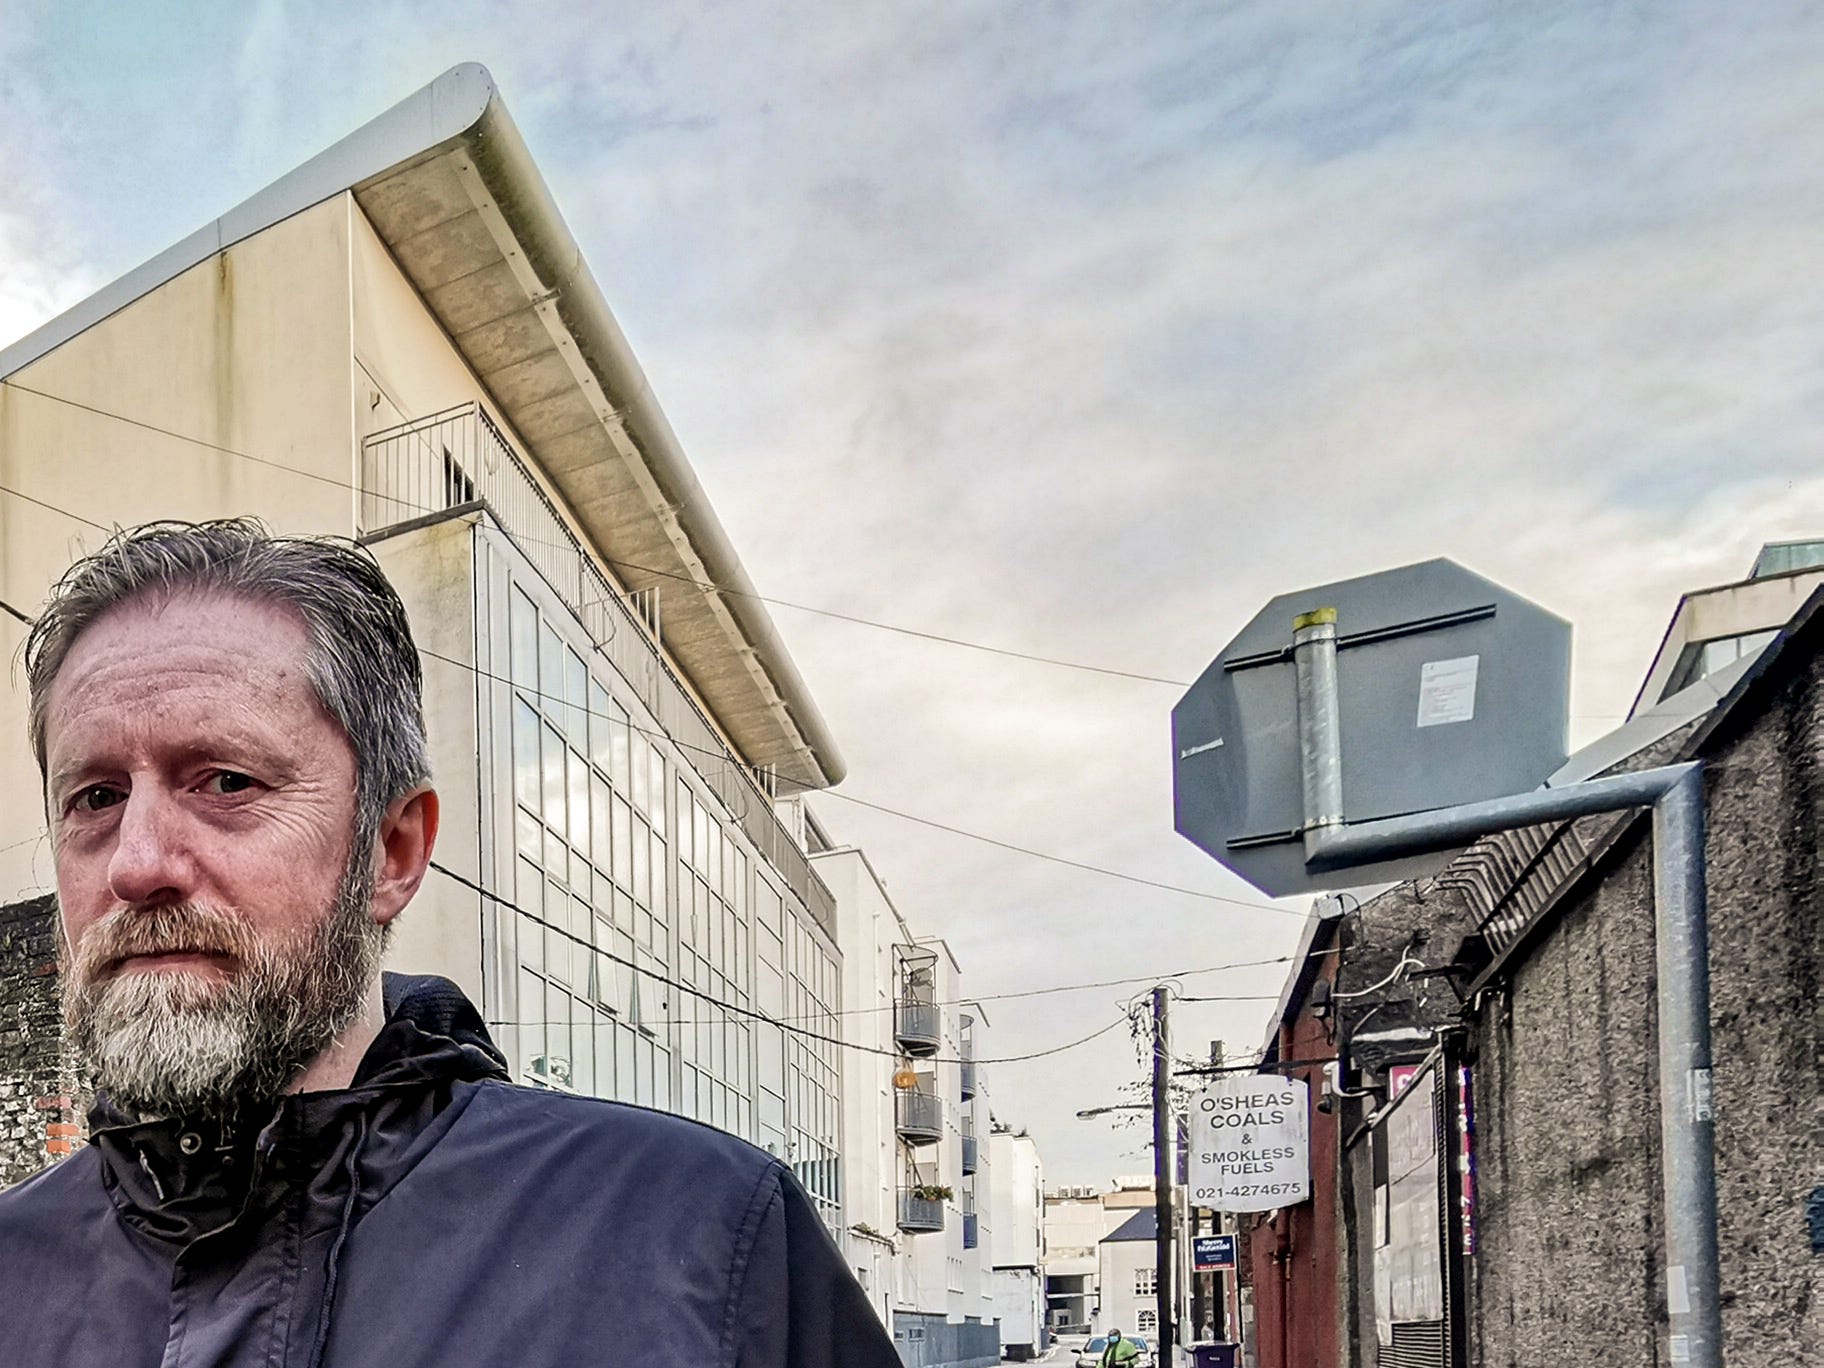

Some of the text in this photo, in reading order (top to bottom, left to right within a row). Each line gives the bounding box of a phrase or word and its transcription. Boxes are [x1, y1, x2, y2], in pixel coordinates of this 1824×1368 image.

[1200, 1092, 1294, 1112] O'SHEAS
[1210, 1110, 1284, 1129] COALS
[1241, 1133, 1252, 1145] &
[1201, 1147, 1295, 1164] SMOKLESS
[1221, 1161, 1274, 1175] FUELS
[1196, 1182, 1301, 1199] 021-4274675
